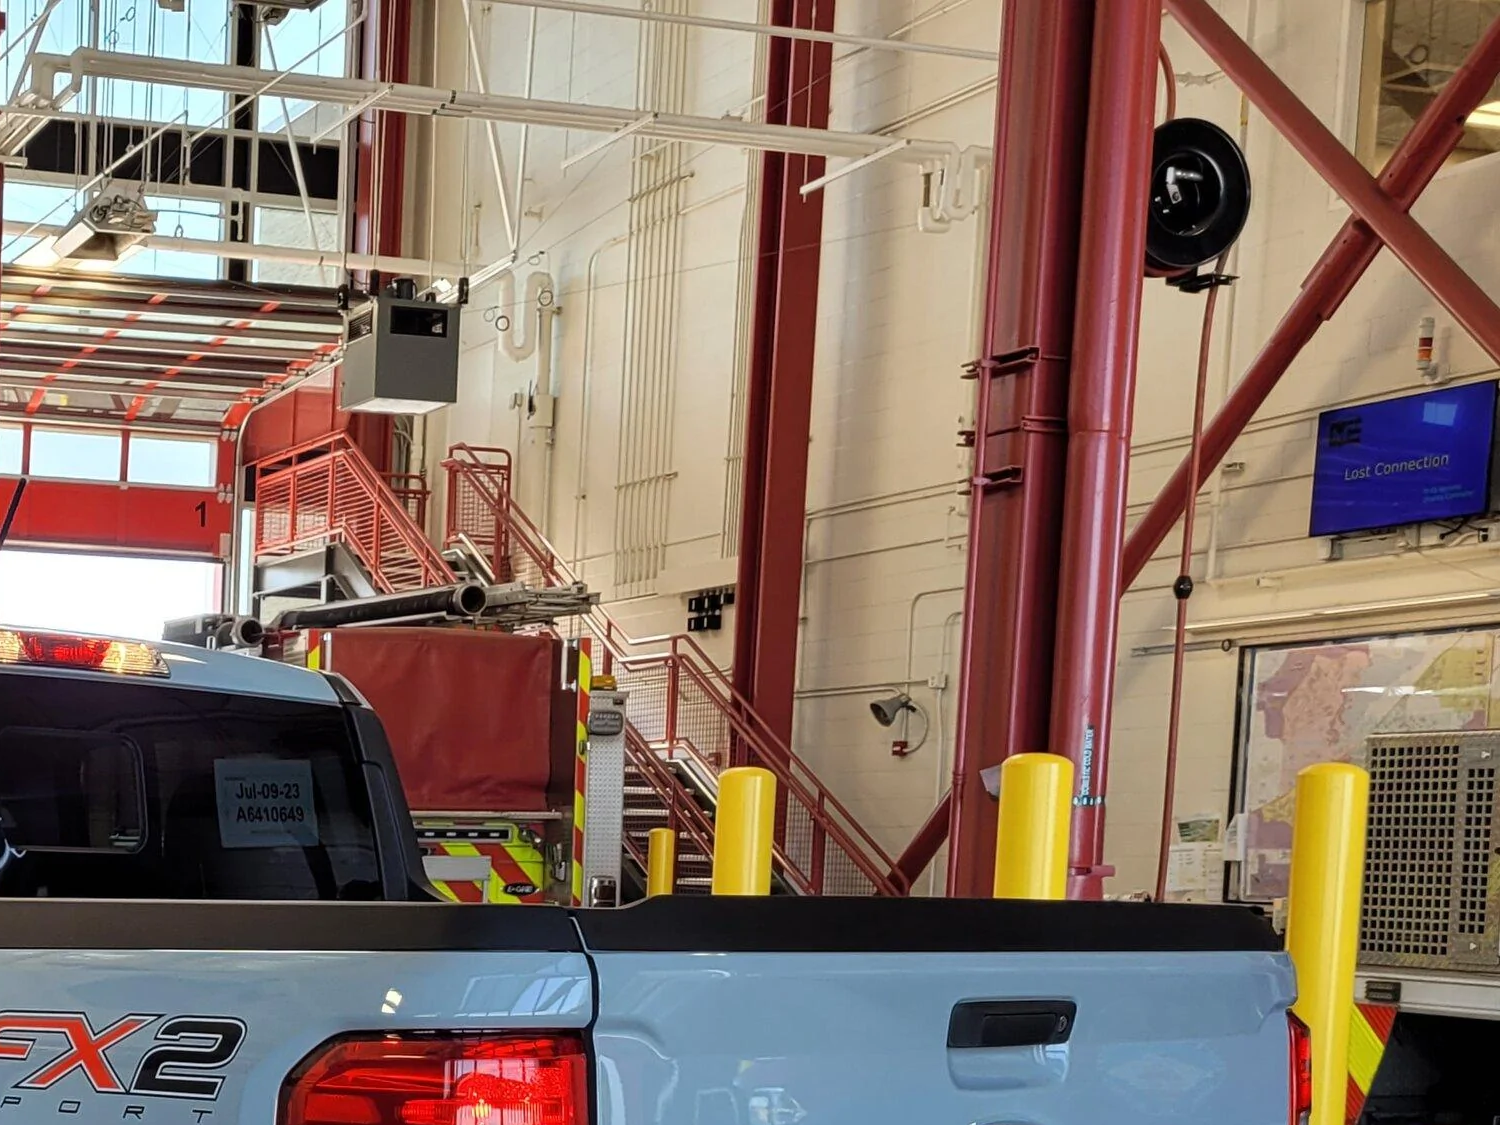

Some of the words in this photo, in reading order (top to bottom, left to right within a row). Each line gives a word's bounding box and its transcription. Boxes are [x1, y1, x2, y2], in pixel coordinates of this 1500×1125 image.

[1344, 465, 1371, 481] Lost
[1374, 453, 1449, 477] Connection
[194, 500, 206, 528] 1
[235, 782, 300, 800] Jul-09-23
[236, 805, 305, 823] A6410649
